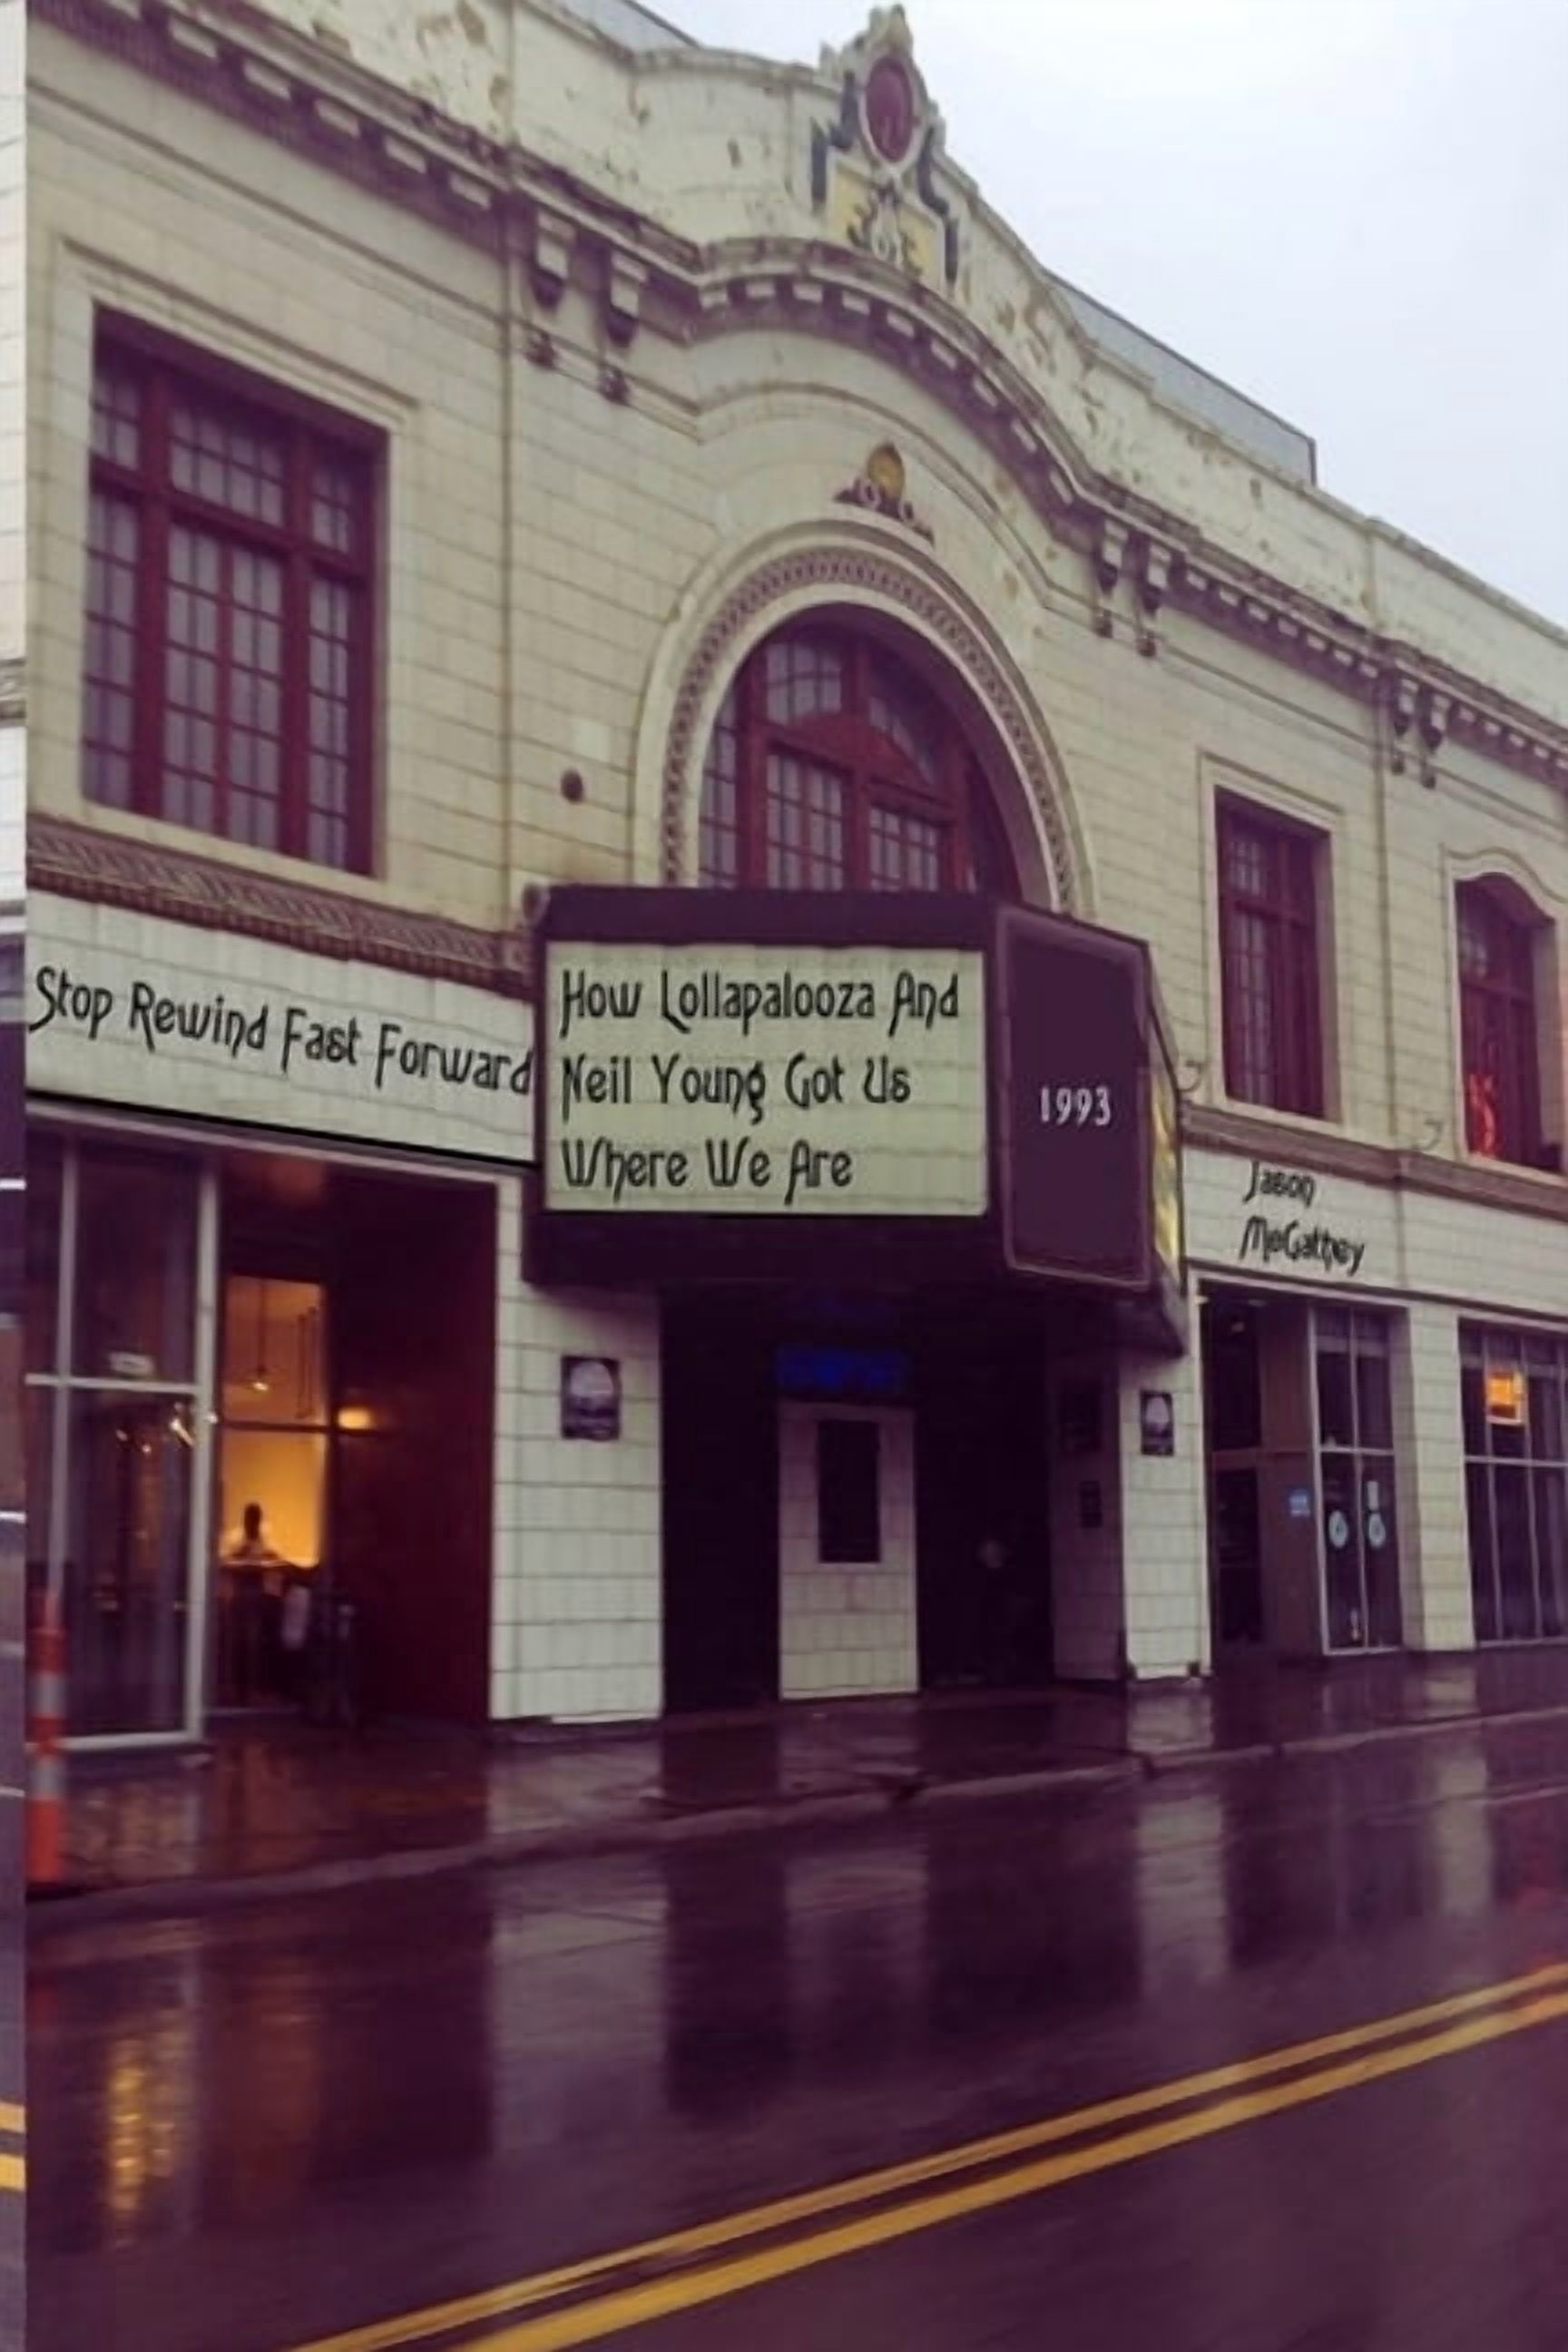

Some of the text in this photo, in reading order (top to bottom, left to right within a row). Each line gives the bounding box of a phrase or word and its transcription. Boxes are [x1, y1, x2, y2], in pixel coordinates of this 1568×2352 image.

[28, 965, 534, 1095] Stop Rewind Fast Forward
[560, 969, 958, 1038] How Lollapalooza And
[562, 1053, 911, 1125] Neil Young Got Us
[1040, 1086, 1112, 1126] 1993
[561, 1136, 853, 1206] Where We Are
[1242, 1160, 1316, 1208] Jason
